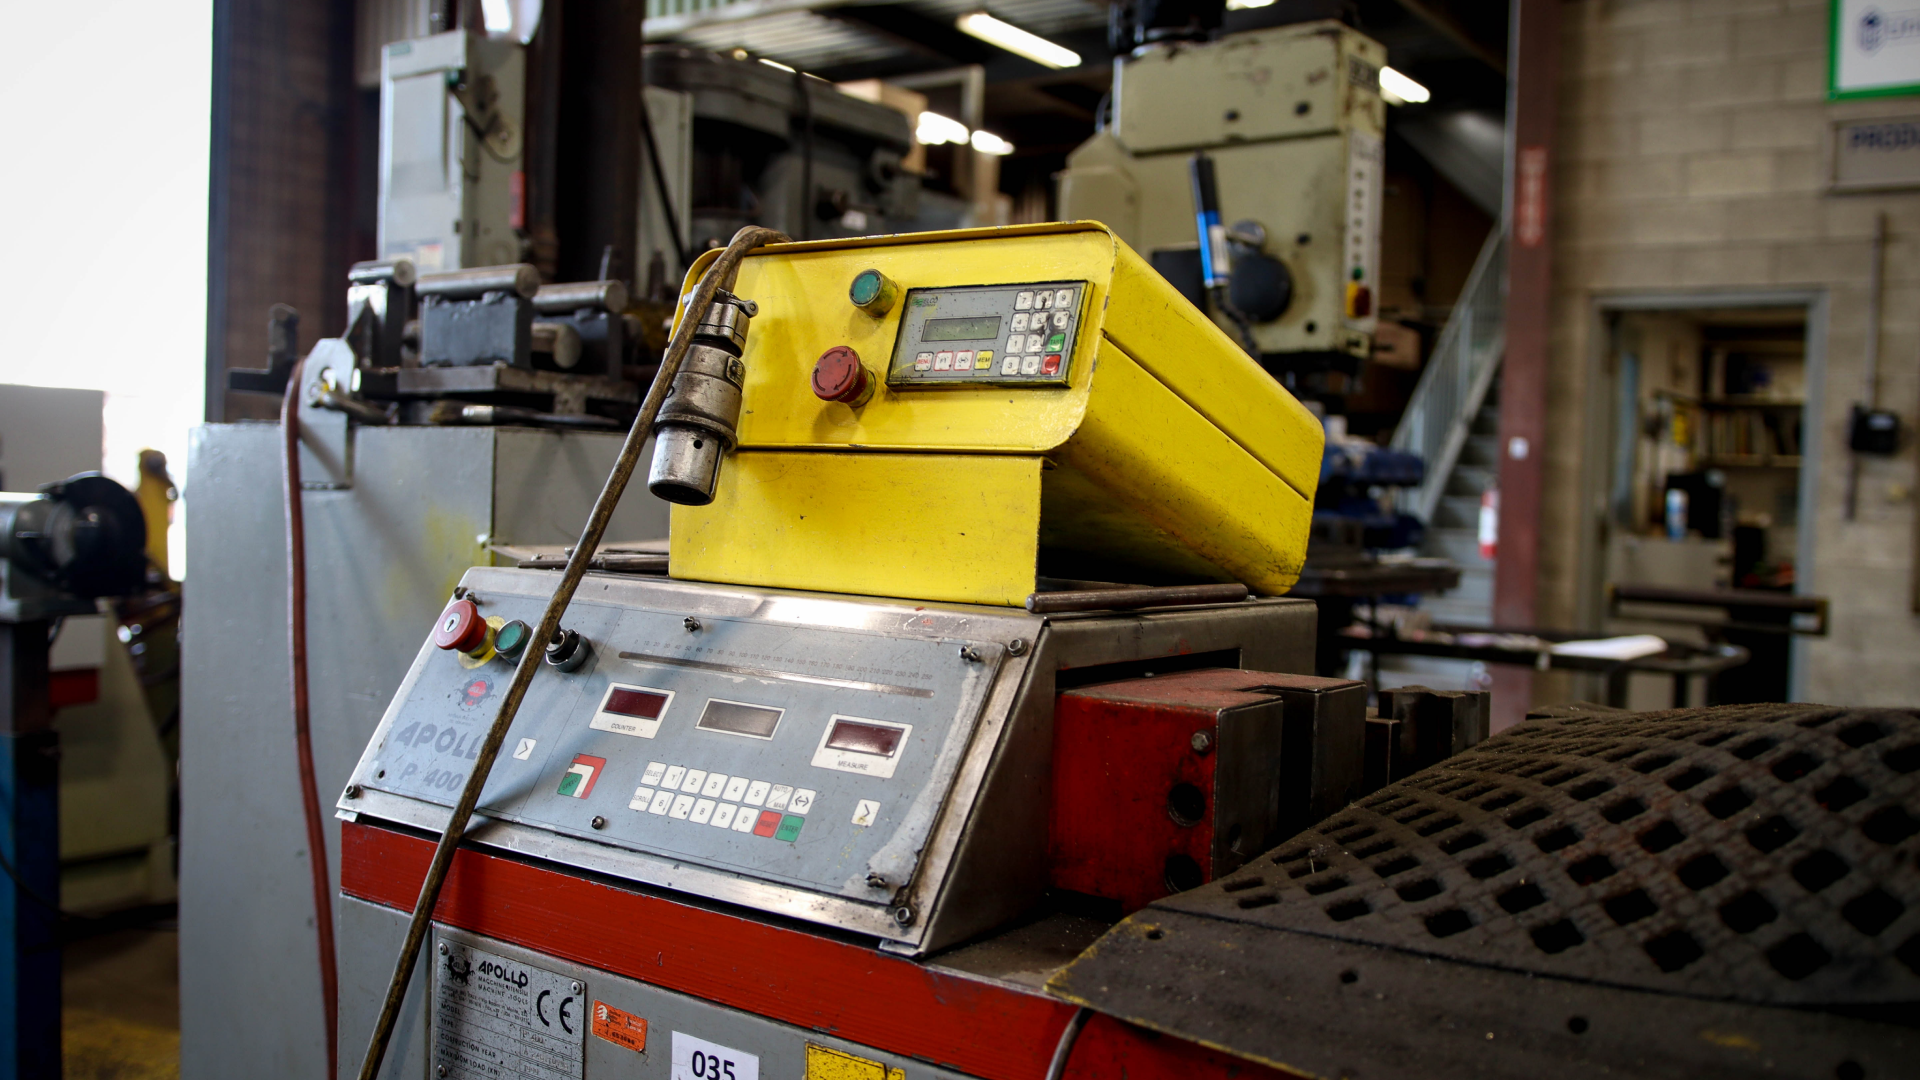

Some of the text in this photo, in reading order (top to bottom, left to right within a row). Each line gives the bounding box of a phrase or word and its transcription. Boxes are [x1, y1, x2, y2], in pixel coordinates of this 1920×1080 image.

[610, 722, 637, 732] COUNTER
[394, 721, 506, 761] APOLL
[836, 760, 869, 771] MEASURE
[398, 762, 464, 792] P 400
[644, 769, 663, 778] SELECT
[562, 776, 579, 791] SPEED
[774, 785, 788, 793] AUTO
[632, 794, 651, 804] SCROLL
[781, 823, 799, 834] ENTER
[478, 960, 528, 988] APOLLO
[478, 984, 506, 998] MACHINE
[441, 1002, 460, 1015] MODEL
[537, 989, 573, 1035] CE
[482, 1048, 496, 1059] YEAR
[470, 1059, 486, 1071] LOAD
[691, 1050, 736, 1080] 035
